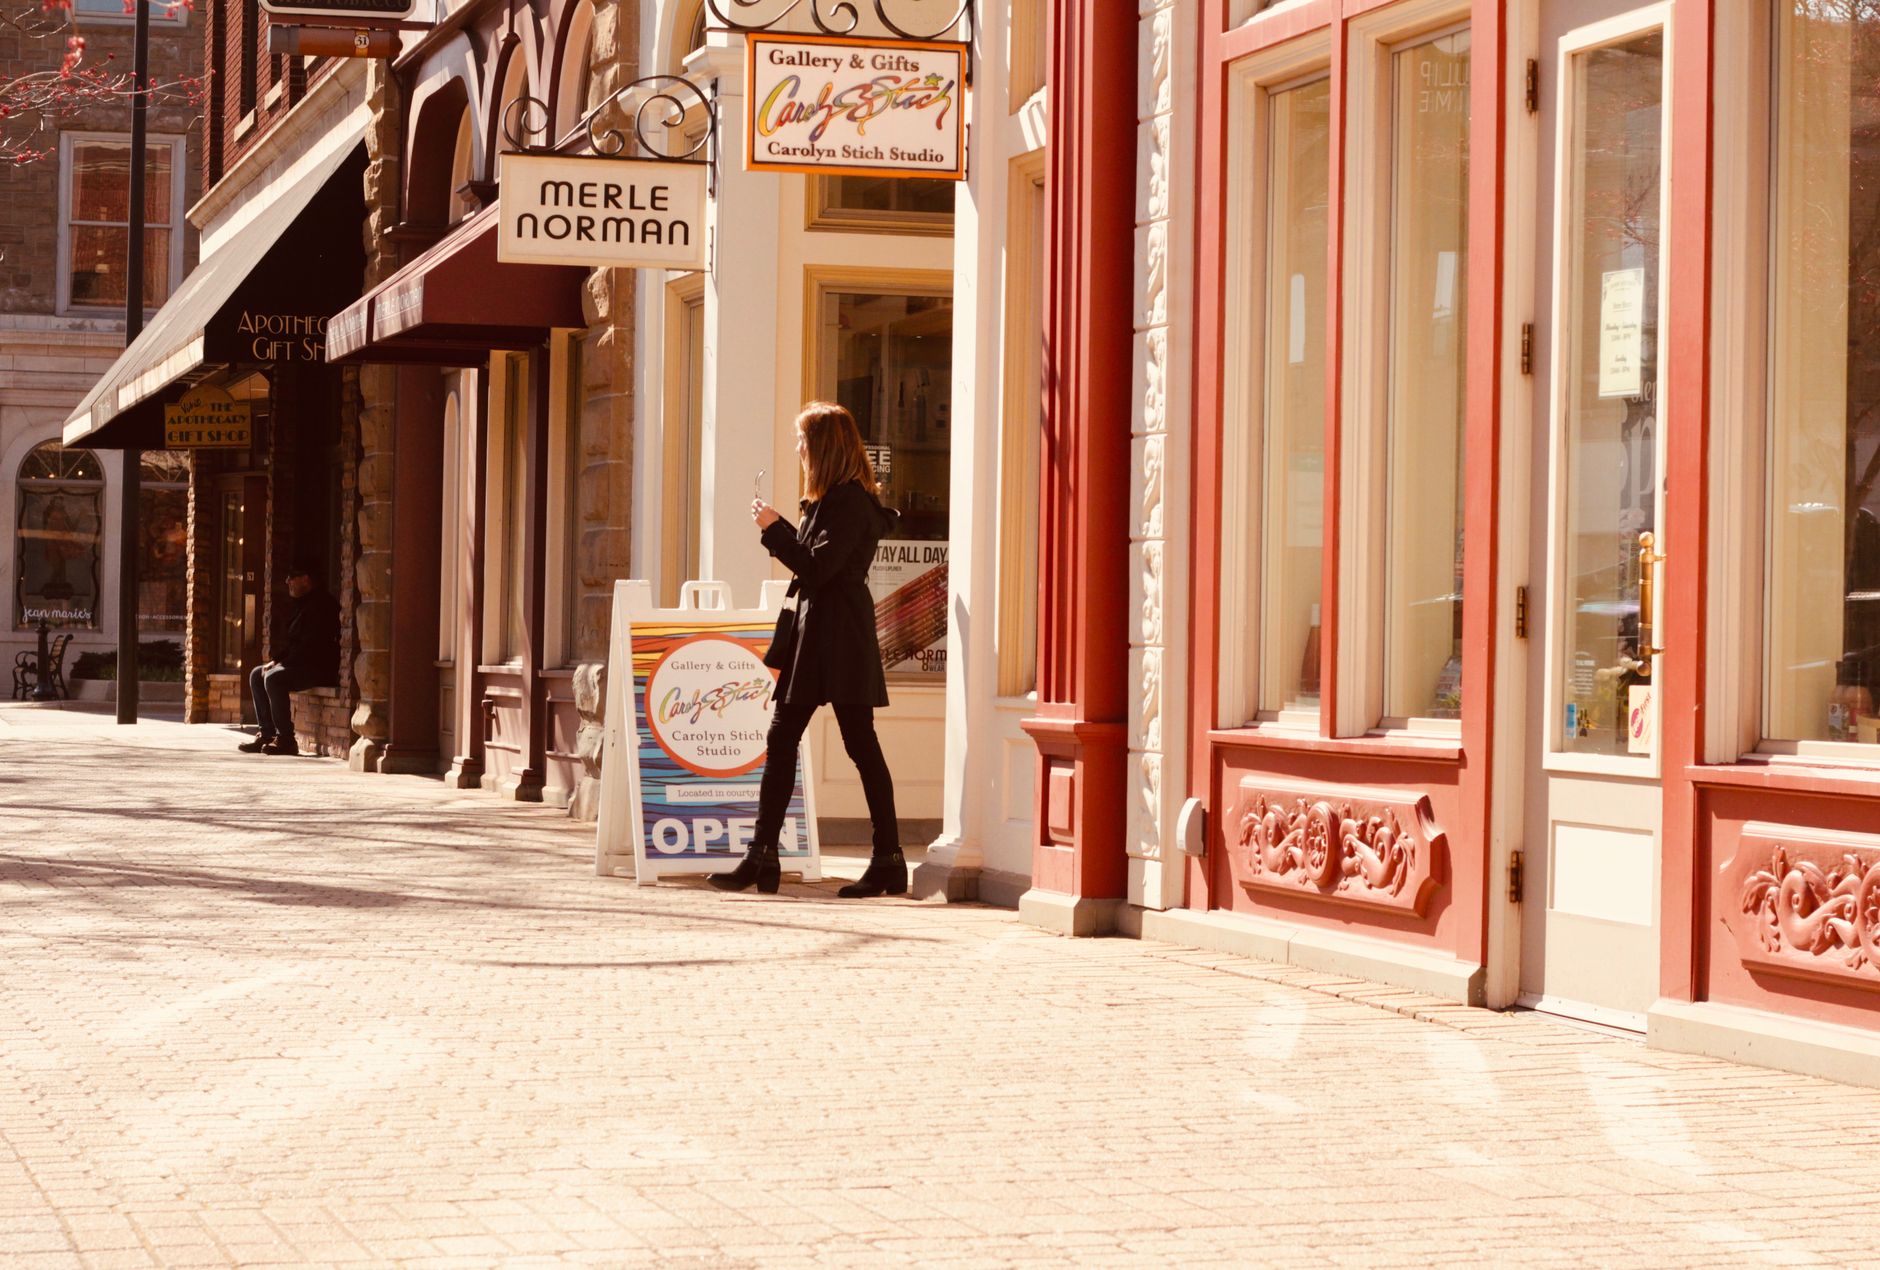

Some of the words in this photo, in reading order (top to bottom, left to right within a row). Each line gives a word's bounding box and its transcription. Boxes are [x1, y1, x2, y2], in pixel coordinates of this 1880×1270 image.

[769, 49, 843, 72] Gallery
[849, 54, 865, 70] &
[871, 54, 920, 72] Gifts
[767, 141, 837, 161] Carolyn
[841, 145, 884, 160] Stich
[889, 147, 944, 163] Studio
[540, 180, 669, 211] MERLE
[516, 212, 689, 246] NORMAN
[252, 336, 295, 360] GIFT
[210, 402, 232, 412] THE
[167, 431, 206, 442] GIFT
[207, 431, 249, 442] SHOP
[898, 546, 921, 564] ALL
[923, 547, 948, 564] DAY
[671, 661, 712, 672] Gallery
[715, 661, 725, 670] &
[728, 661, 756, 671] Gifts
[671, 730, 725, 744] Carolyn
[730, 730, 764, 741] Stich
[696, 745, 741, 756] Studio
[677, 789, 713, 798] Located
[715, 789, 724, 797] in
